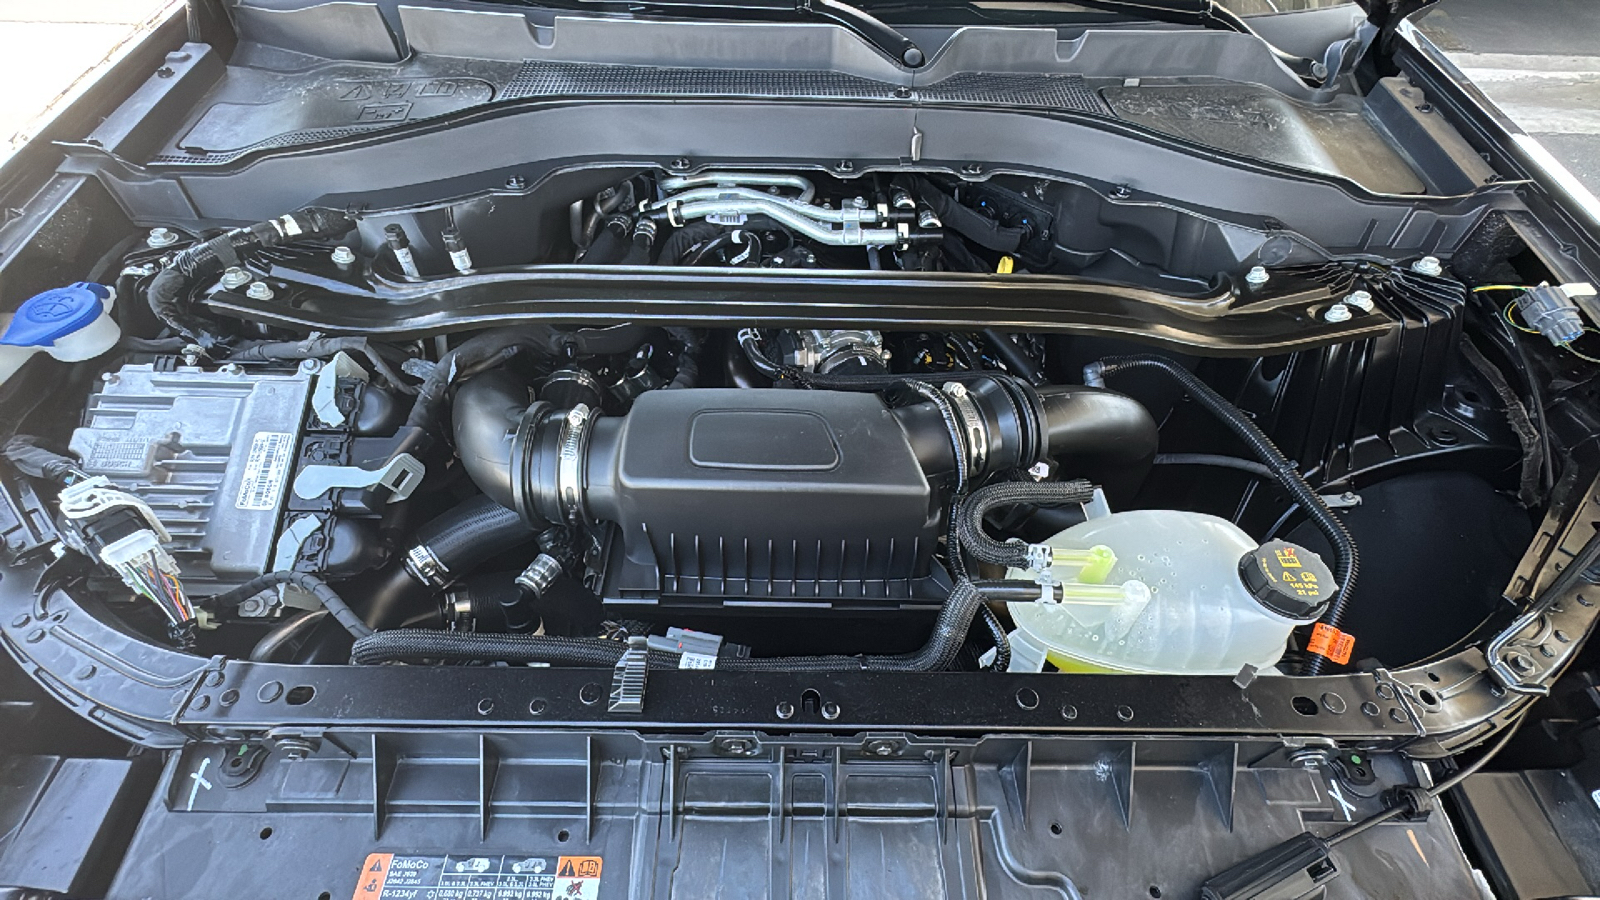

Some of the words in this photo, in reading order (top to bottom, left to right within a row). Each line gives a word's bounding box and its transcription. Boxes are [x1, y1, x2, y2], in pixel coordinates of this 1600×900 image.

[391, 860, 428, 868] FoMoCo
[383, 889, 418, 899] R-1234yf
[455, 890, 463, 898] kg
[483, 890, 492, 898] kg
[515, 890, 522, 899] kg
[543, 891, 550, 900] kg
